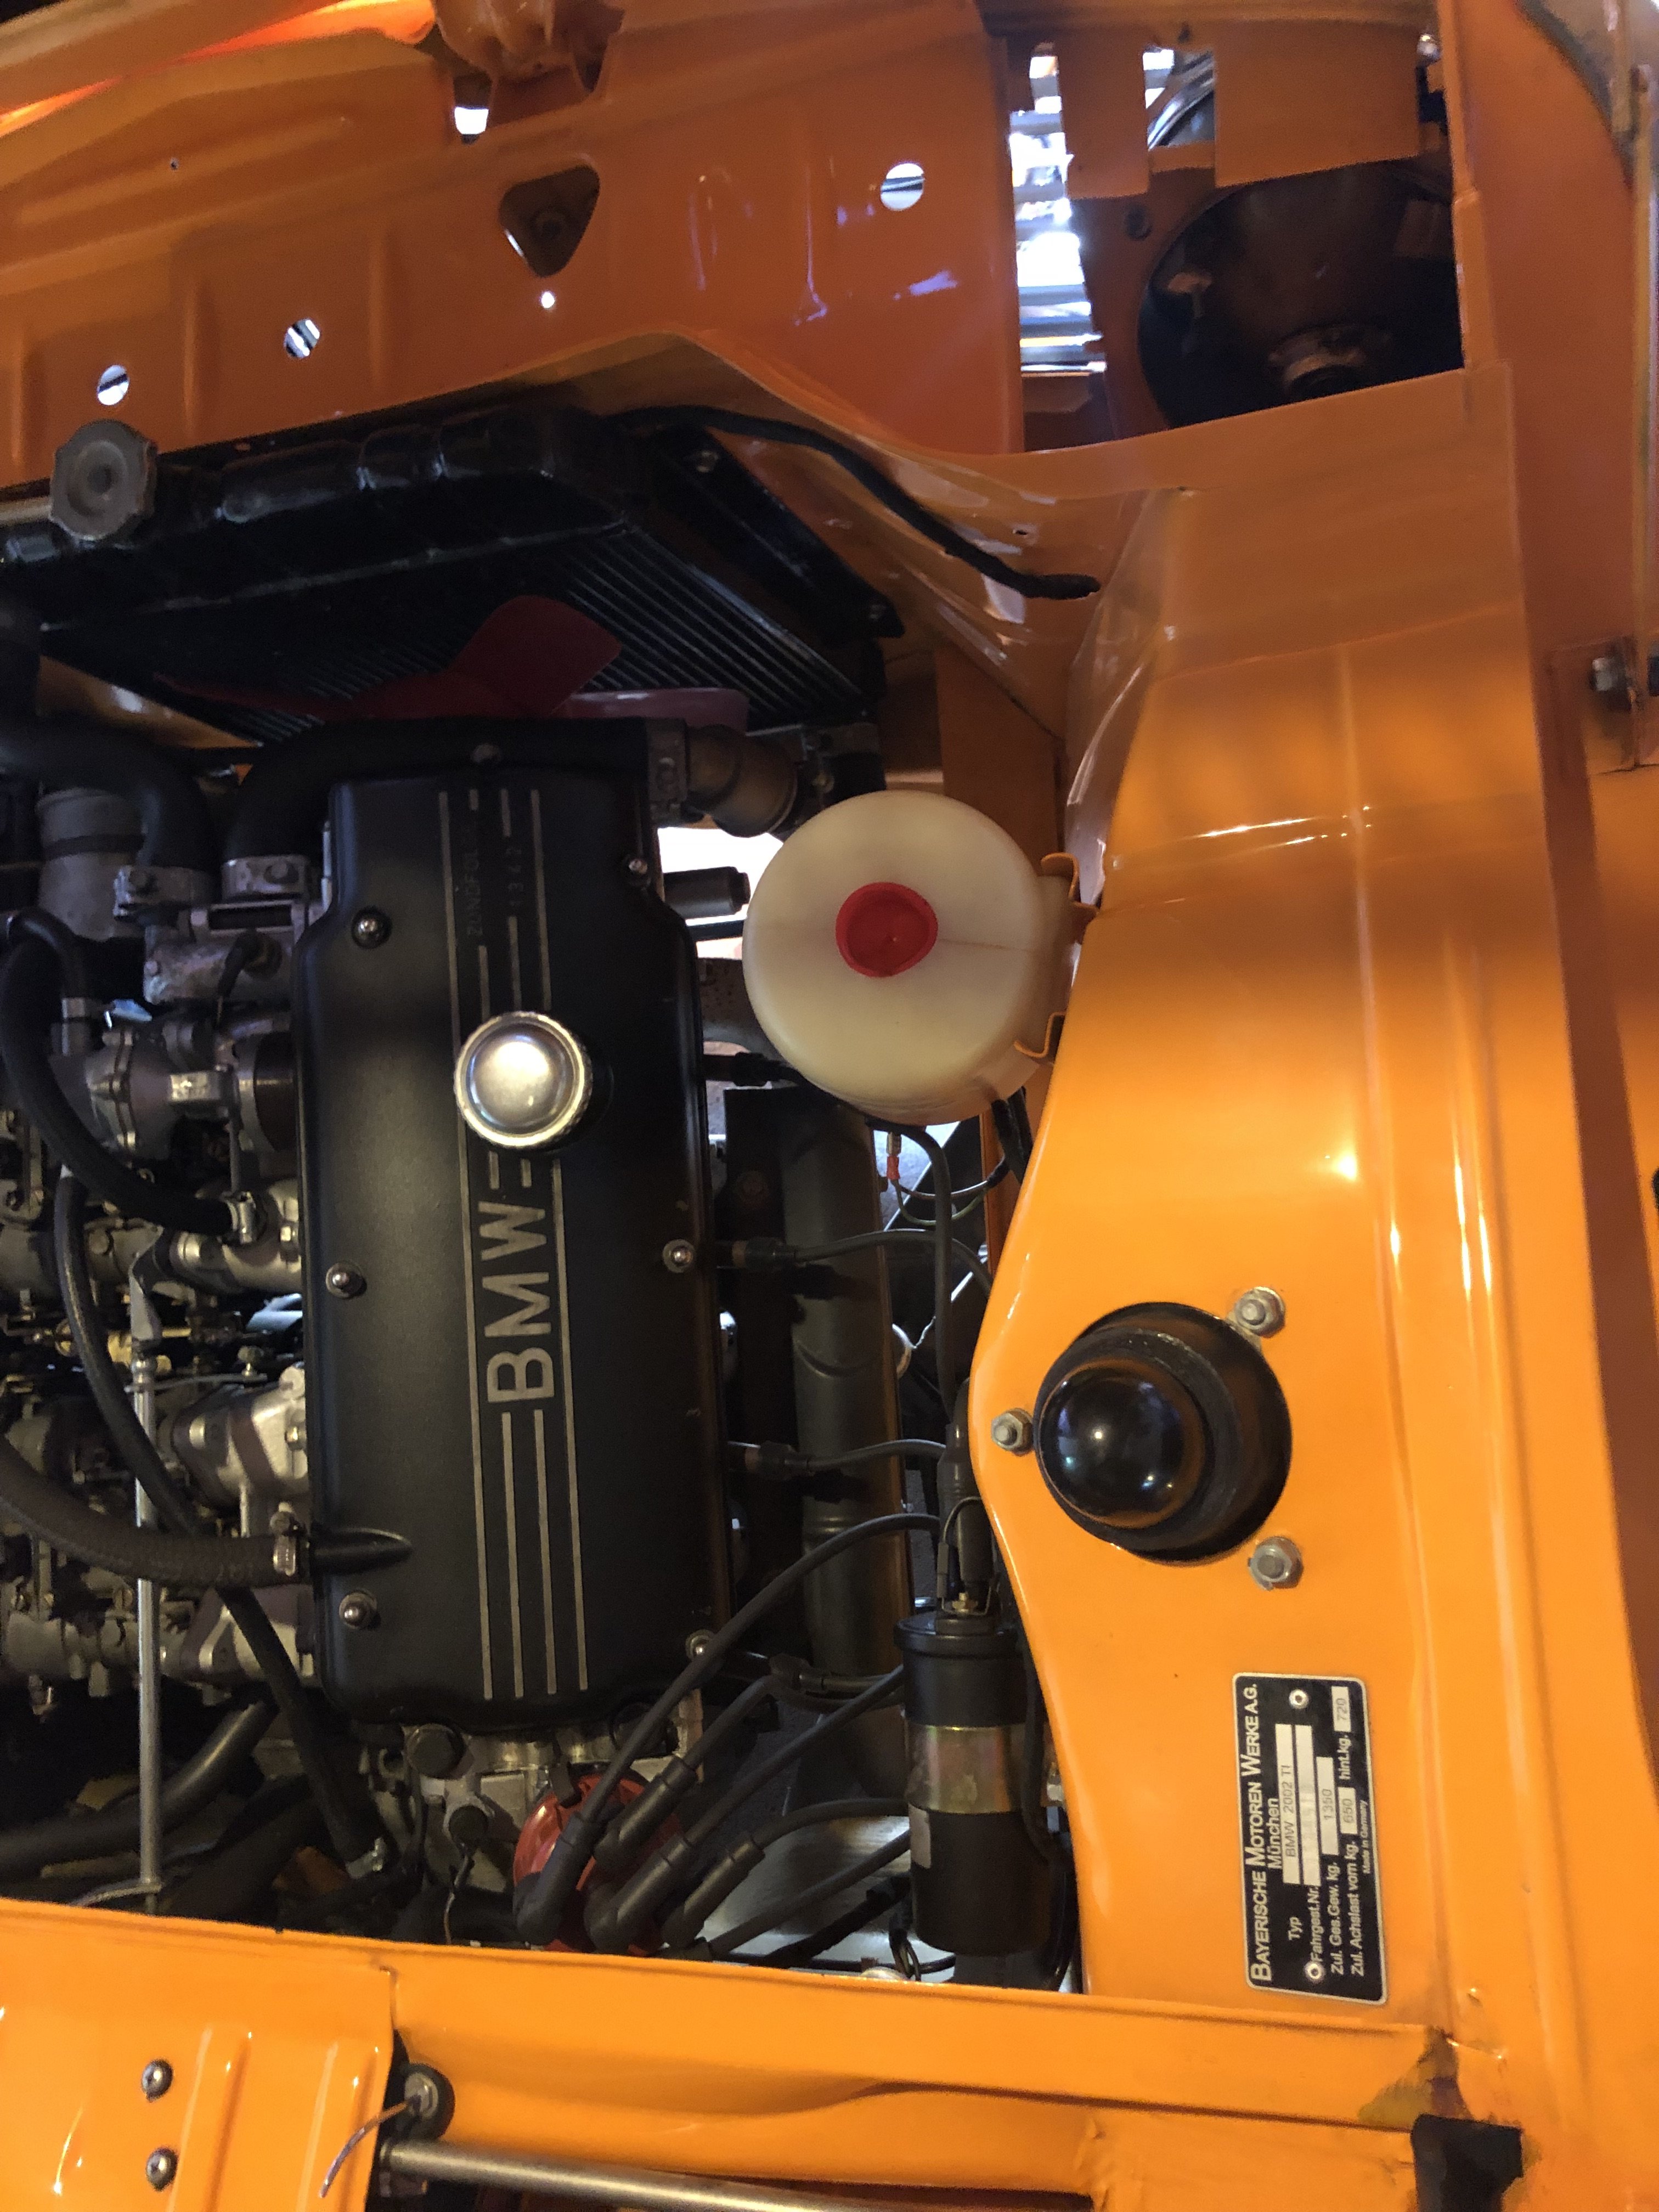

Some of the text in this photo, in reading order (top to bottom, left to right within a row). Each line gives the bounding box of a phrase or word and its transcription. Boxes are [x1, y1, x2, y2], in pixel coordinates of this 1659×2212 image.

[477, 1201, 556, 1403] BMW
[1335, 1697, 1347, 1722] 720
[1321, 1788, 1334, 1820] 1350
[1342, 1798, 1354, 1824] 650
[1240, 1683, 1272, 1980] BAYERISCHE MOTOREN WERKE A.G.
[1266, 1797, 1282, 1870] München
[1359, 1799, 1370, 1874] Made in Germany
[1281, 1764, 1303, 1940] Typ BMW 2002 TI
[1345, 1841, 1359, 1860] kg.
[1326, 1862, 1340, 1881] kg.
[1347, 1893, 1363, 1949] Achslast
[1330, 1950, 1344, 1974] Zul.
[1351, 1952, 1365, 1976] Zul.
